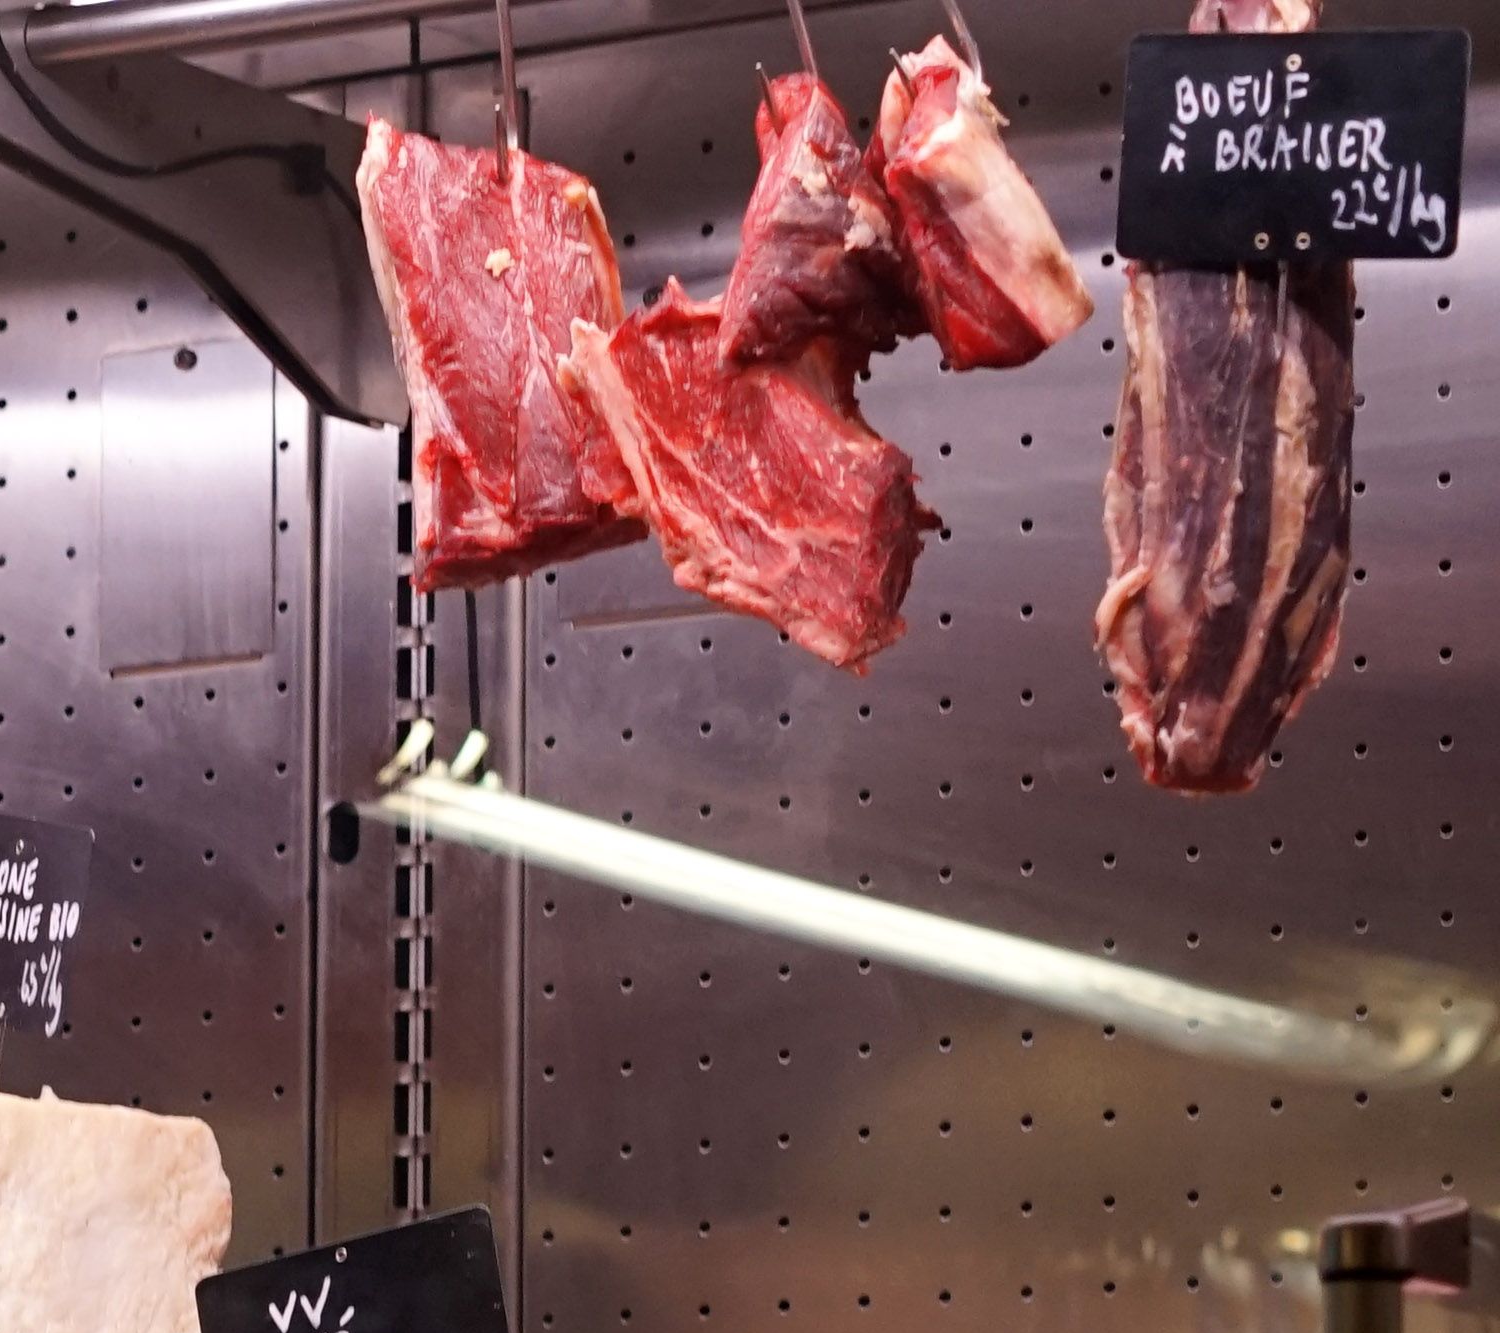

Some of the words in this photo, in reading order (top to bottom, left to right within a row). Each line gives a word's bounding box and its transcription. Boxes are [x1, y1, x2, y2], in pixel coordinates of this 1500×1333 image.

[1176, 69, 1309, 124] BOEUF
[1215, 118, 1392, 173] BRAISER
[49, 900, 80, 942] BIO
